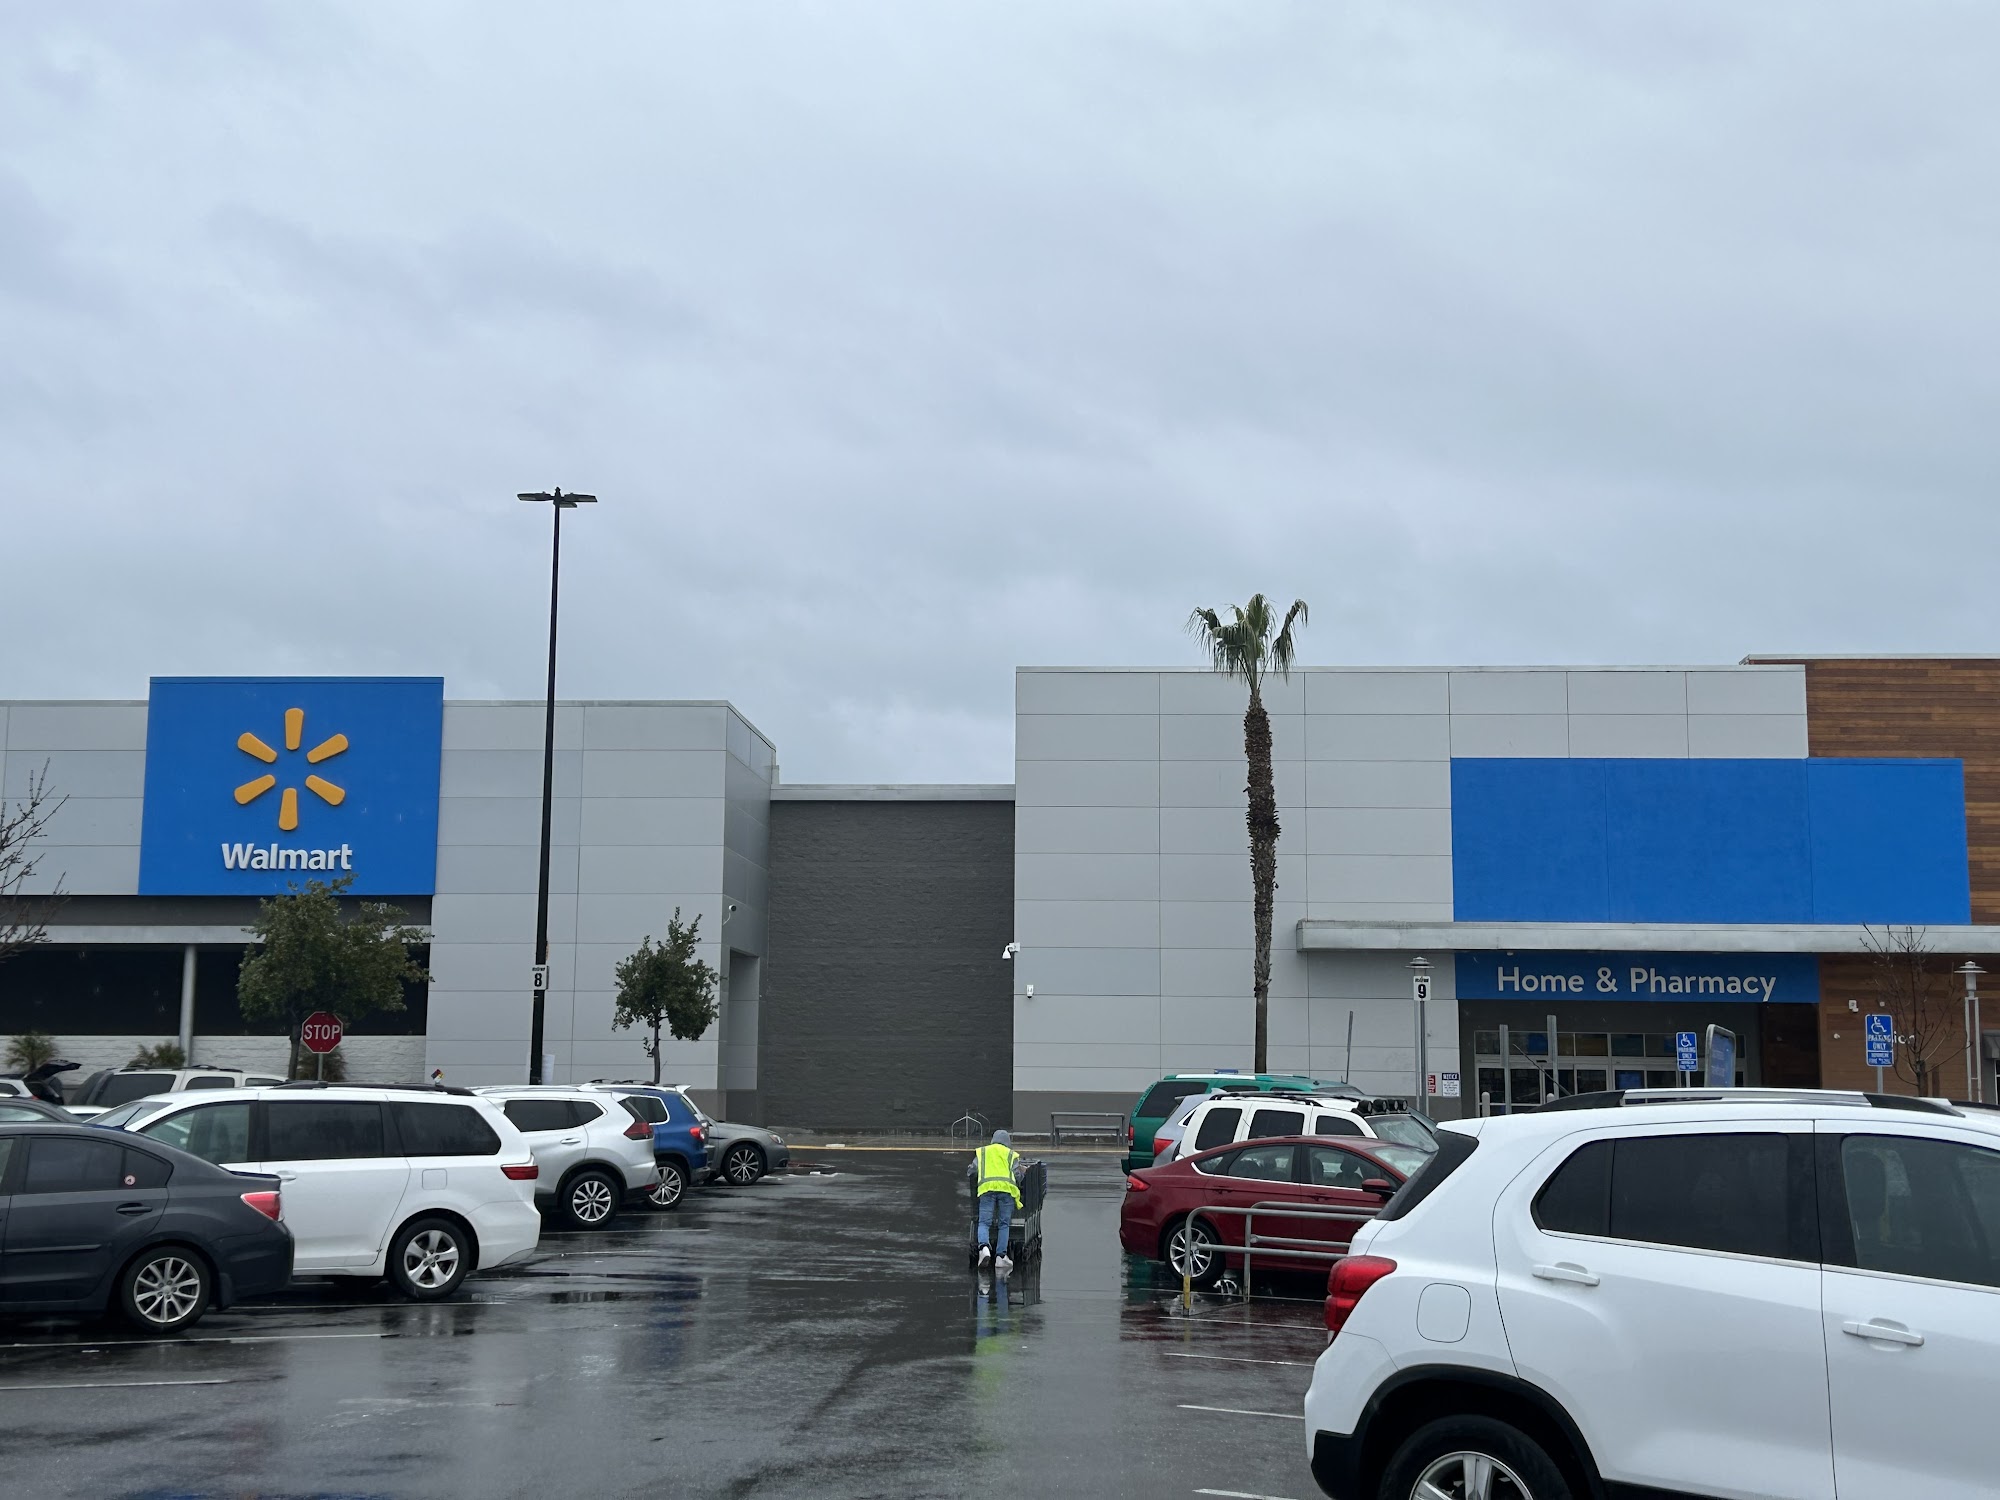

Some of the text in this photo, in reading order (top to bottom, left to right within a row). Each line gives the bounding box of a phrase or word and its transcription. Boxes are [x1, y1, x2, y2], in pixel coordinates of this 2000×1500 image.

[221, 843, 353, 870] Walmart
[534, 972, 543, 988] 8
[1497, 966, 1776, 1002] Home & Pharmacy
[1417, 983, 1427, 999] 9
[303, 1024, 341, 1040] STOP
[1872, 1042, 1887, 1051] ONLY
